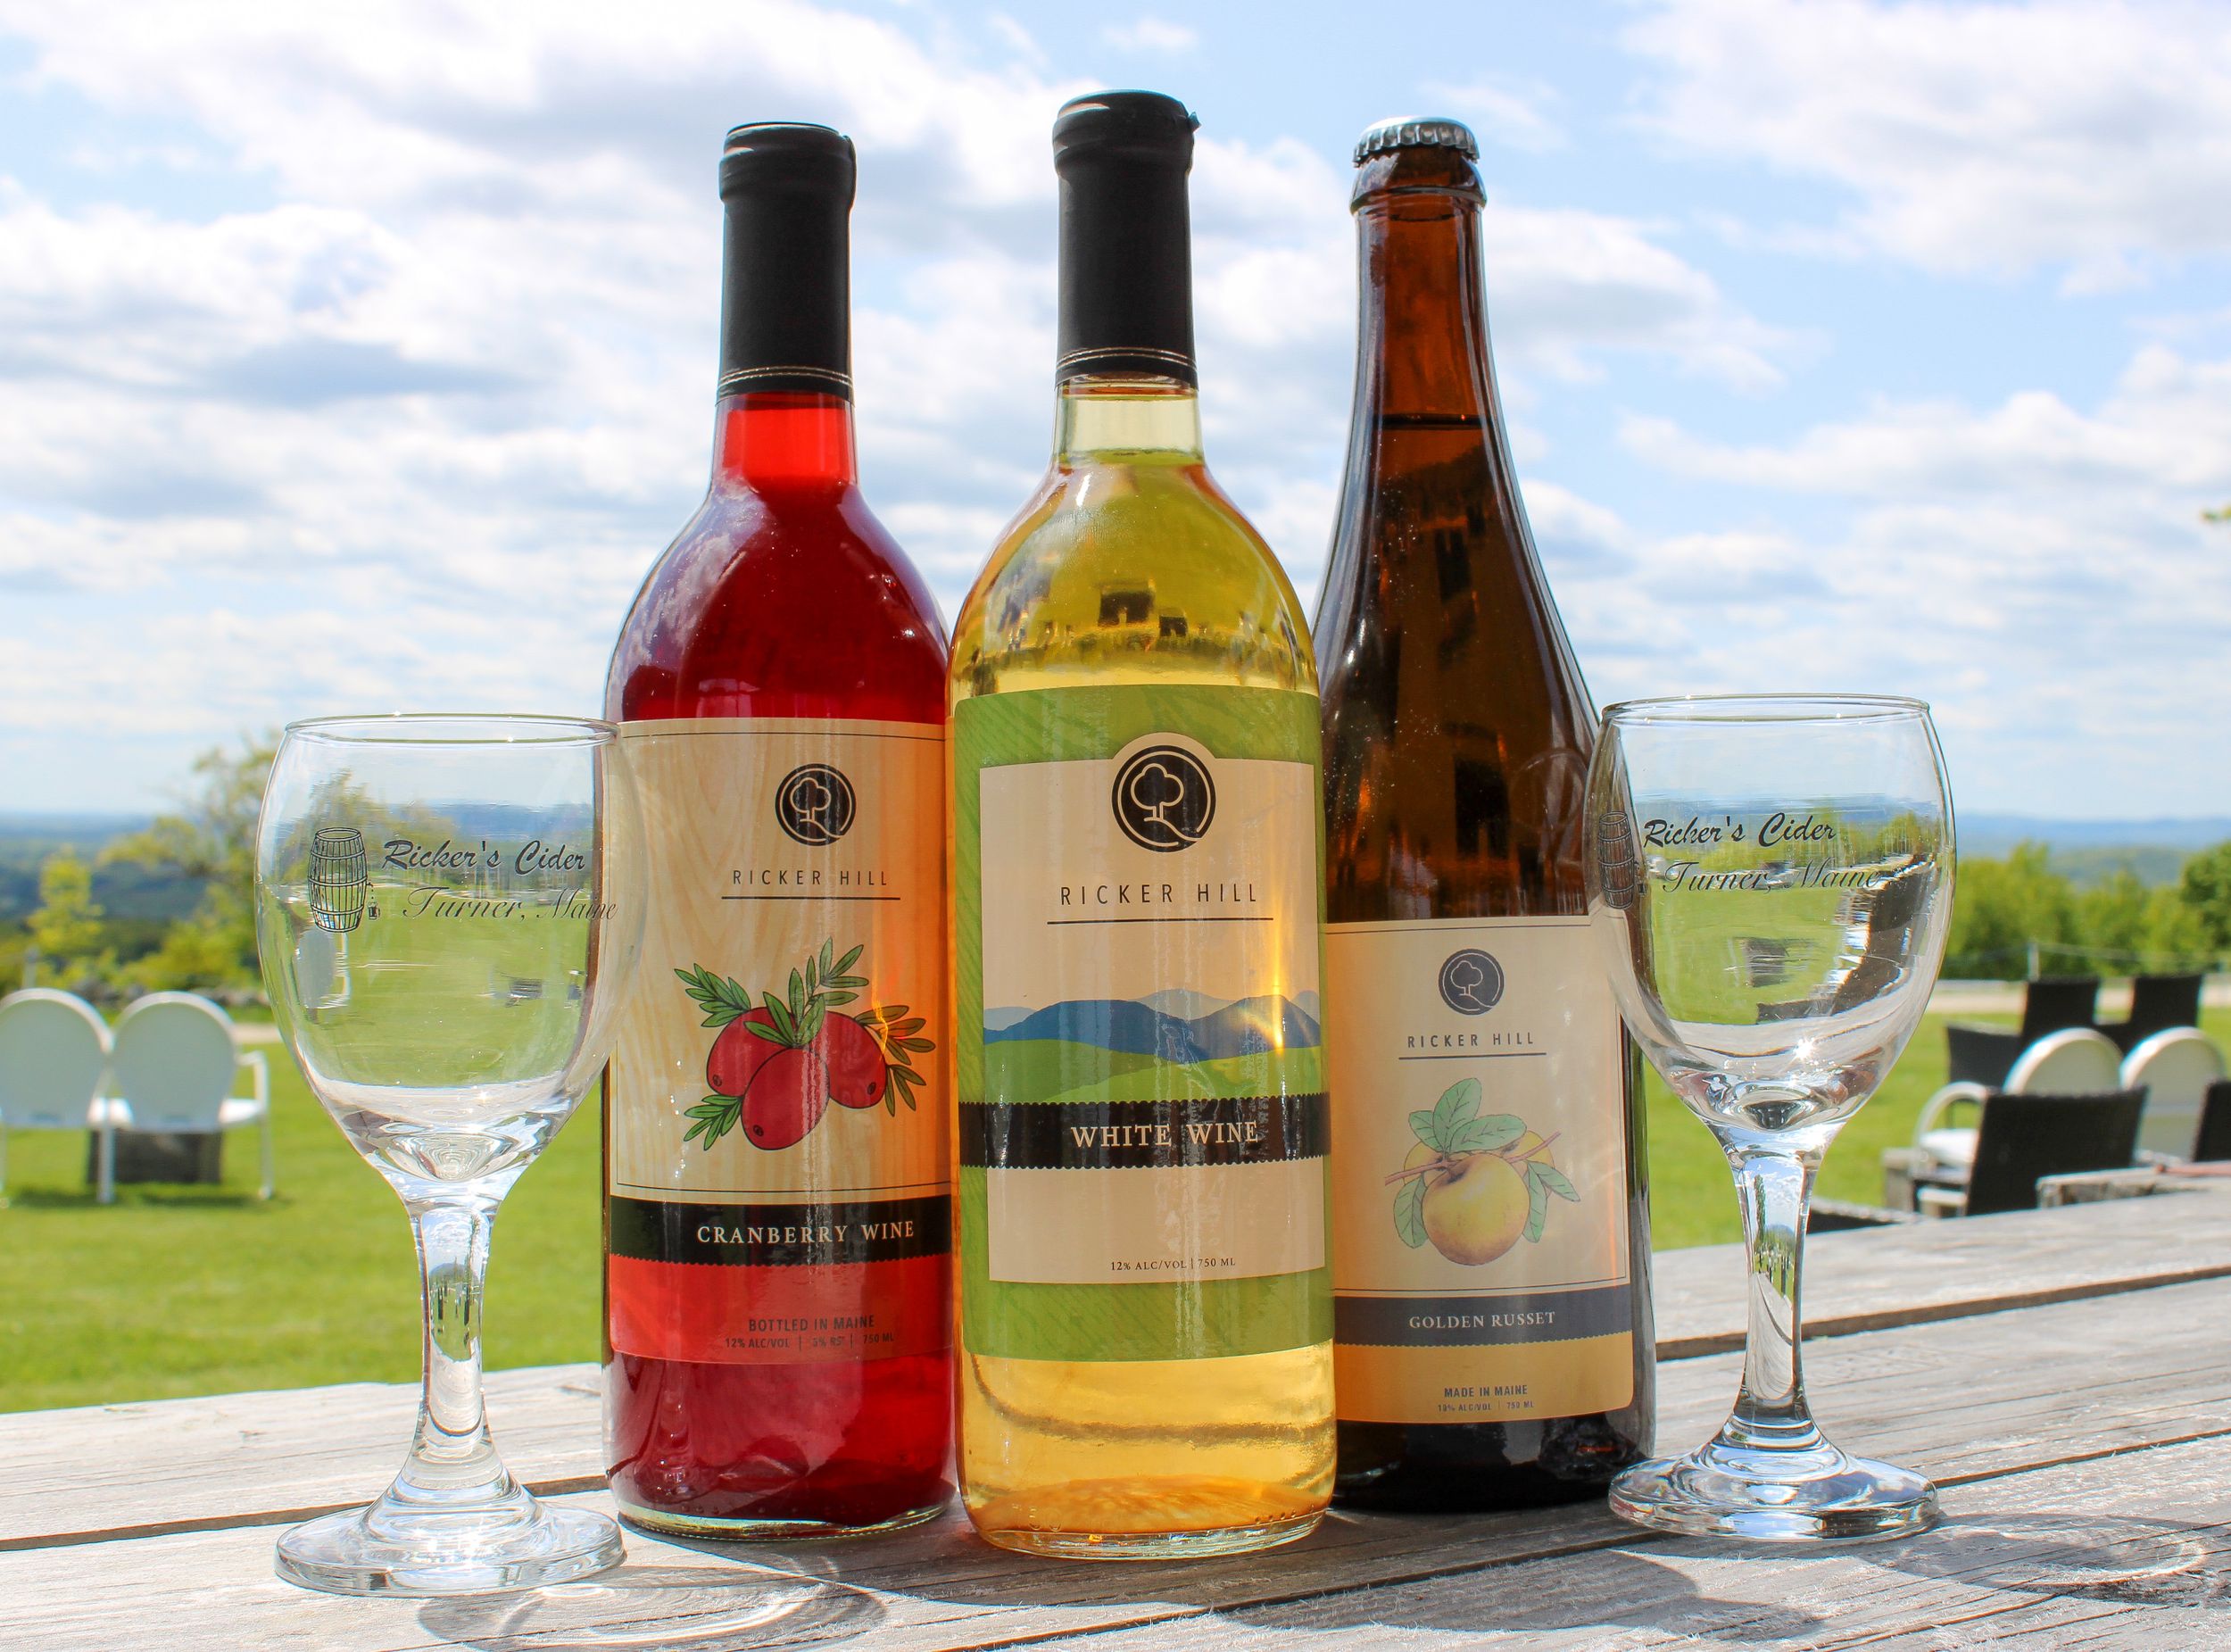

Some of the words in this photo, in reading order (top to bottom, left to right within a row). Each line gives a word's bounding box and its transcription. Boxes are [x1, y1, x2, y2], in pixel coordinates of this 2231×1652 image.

[1644, 816, 1746, 848] Ricker's
[1758, 812, 1837, 848] Cider
[381, 839, 502, 871] Ricker's
[515, 840, 586, 876] Cider
[733, 869, 821, 885] RICKER
[840, 870, 887, 886] HILL
[1663, 861, 1771, 894] Turner,
[1787, 857, 1879, 889] Maine
[402, 886, 527, 922] Turner,
[536, 886, 618, 920] Maine
[1060, 884, 1173, 905] RICKER
[1197, 883, 1256, 903] HILL
[1407, 1034, 1479, 1049] RICKER
[1492, 1032, 1534, 1046] HILL
[1070, 1124, 1172, 1149] WHITE
[1186, 1120, 1259, 1145] WINE
[697, 1224, 849, 1244] CRANBERRY
[860, 1220, 915, 1241] WINE
[1110, 1261, 1131, 1271] 12%
[1135, 1259, 1188, 1271] ALC/VOL
[1198, 1258, 1216, 1268] 750
[1220, 1257, 1236, 1267] ML
[749, 1318, 809, 1332] BOTTLED
[814, 1317, 828, 1331] IN
[834, 1314, 875, 1330] MAINE
[1408, 1315, 1485, 1329] GOLDEN
[1491, 1311, 1556, 1328] RUSSET
[726, 1337, 746, 1349] 12%
[748, 1337, 791, 1349] ALC/VOL
[863, 1333, 880, 1344] 750
[1444, 1386, 1475, 1399] MADE
[1479, 1386, 1490, 1397] IN
[1494, 1384, 1529, 1397] MAINE
